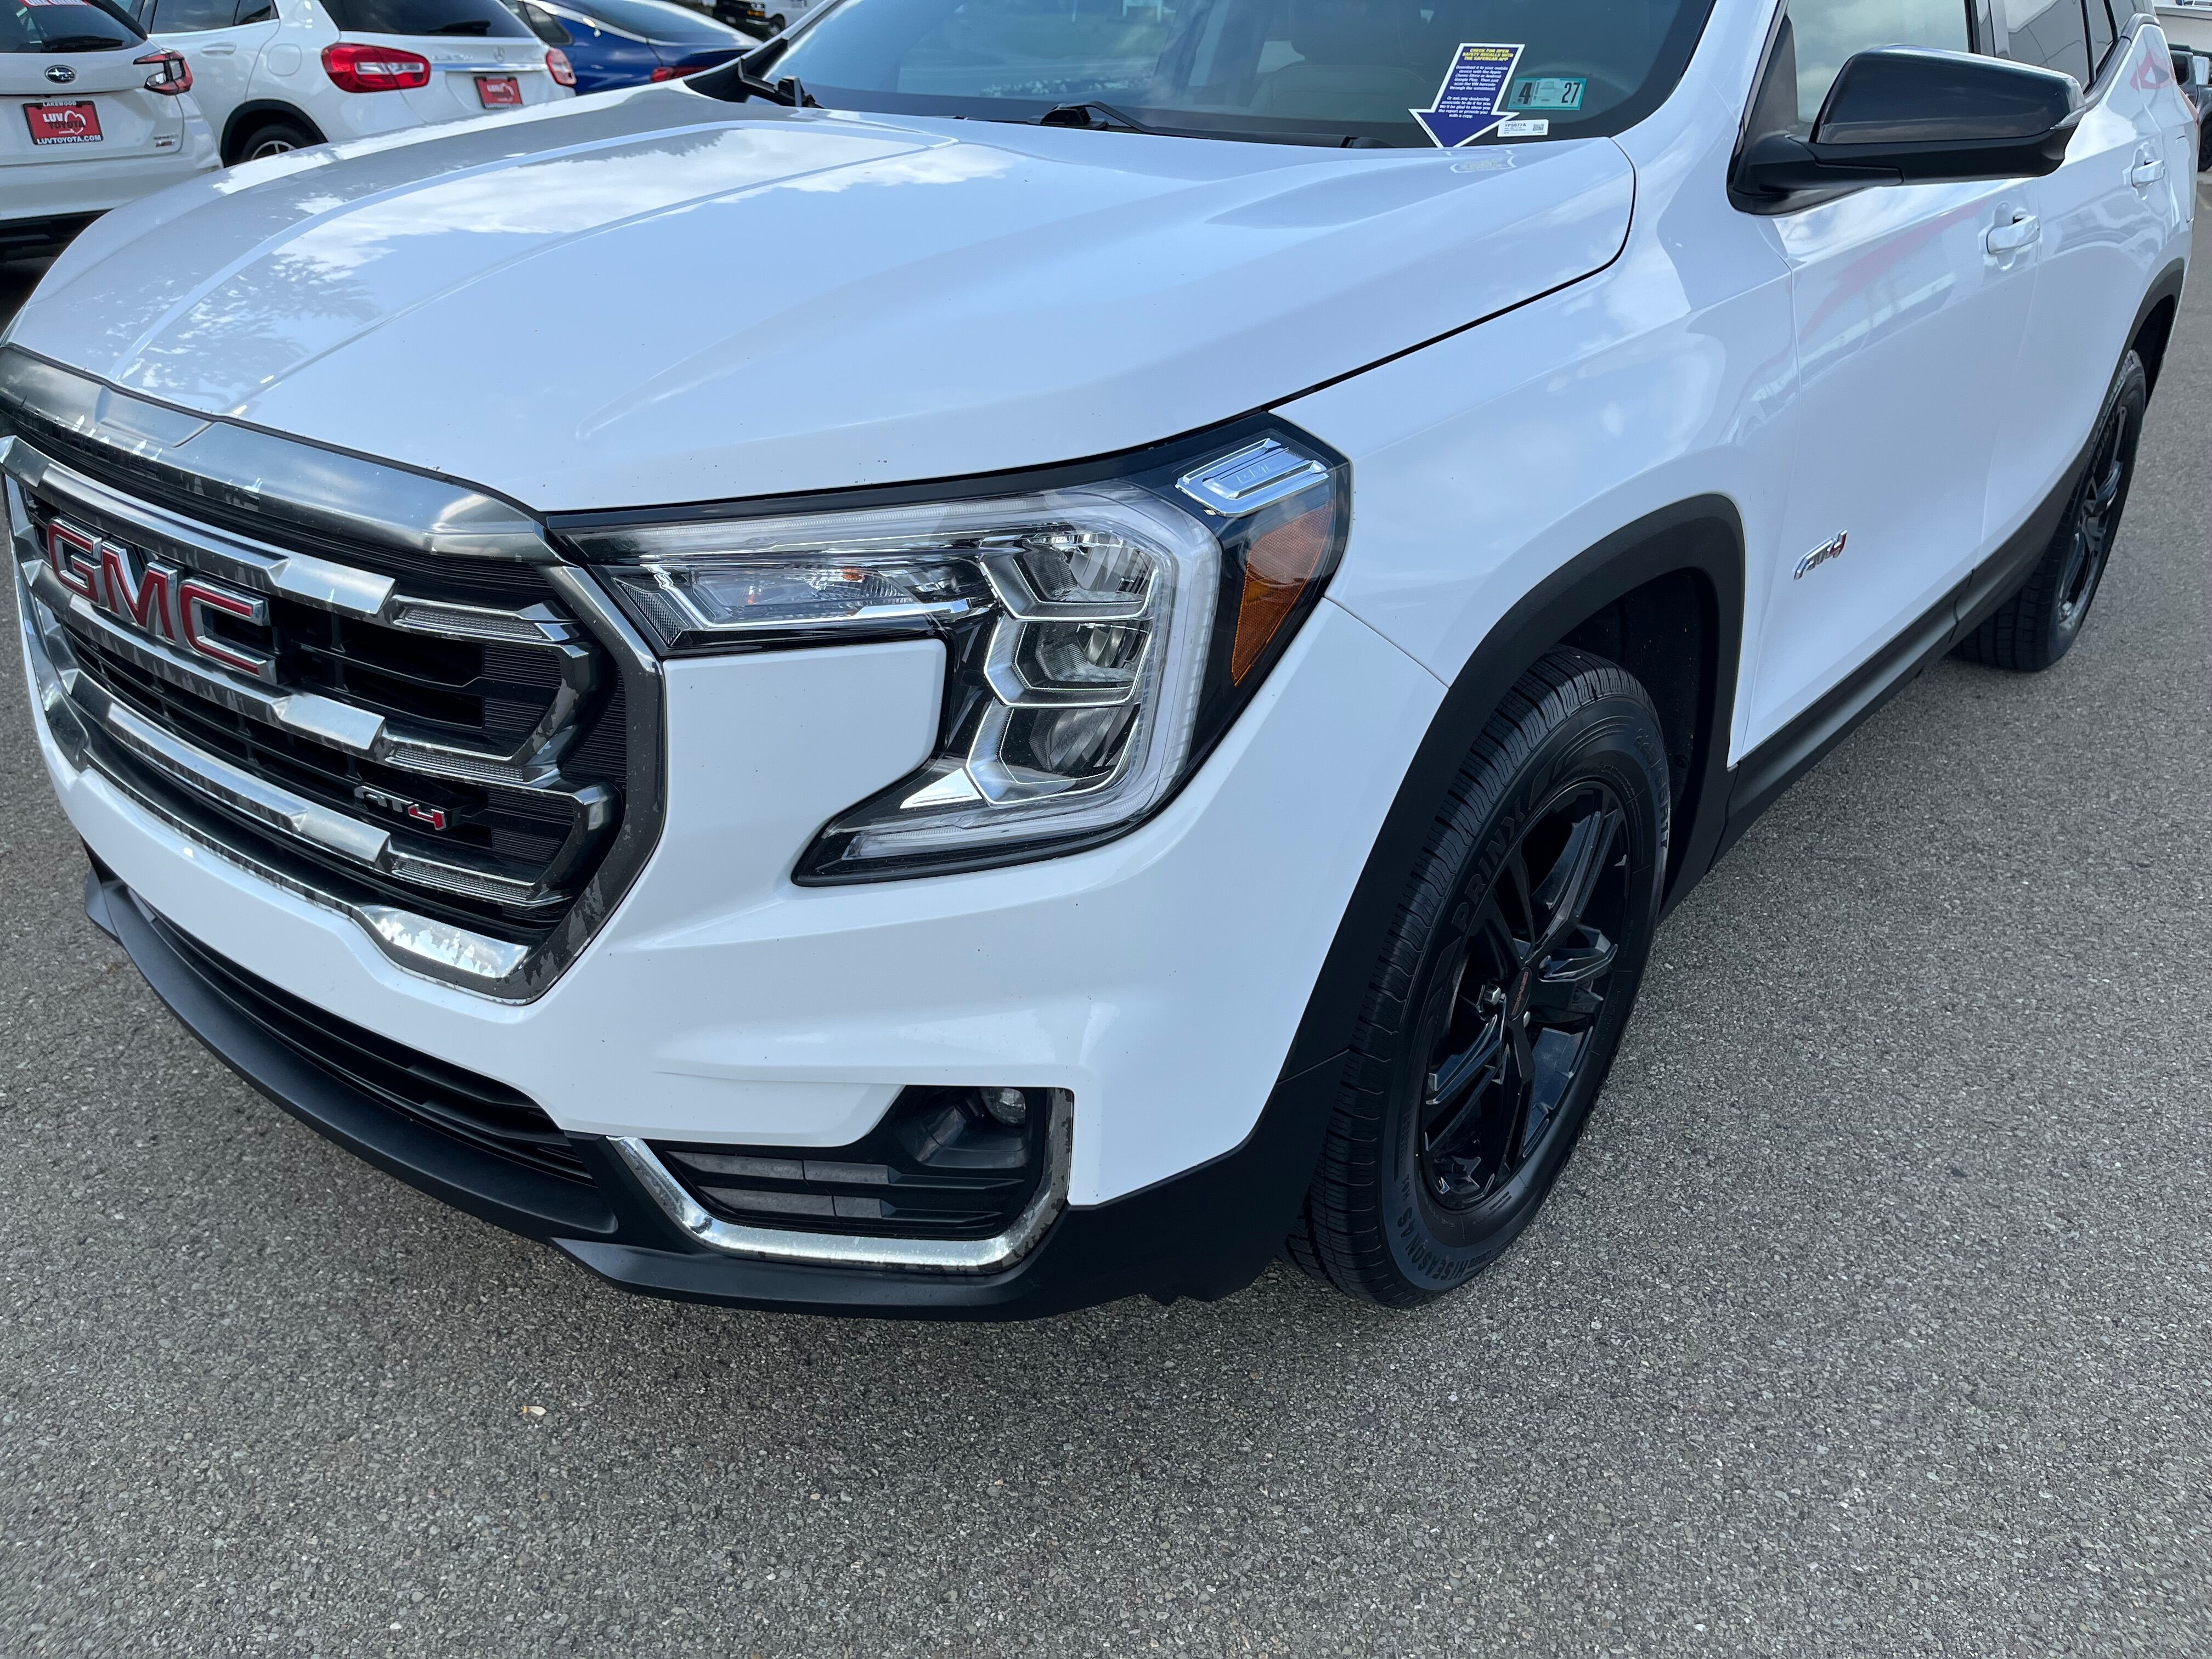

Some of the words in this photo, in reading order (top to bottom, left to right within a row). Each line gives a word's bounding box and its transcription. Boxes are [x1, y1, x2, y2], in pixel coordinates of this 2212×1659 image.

[1519, 82, 1533, 104] 4
[1561, 82, 1581, 103] 27
[42, 113, 63, 122] LUV
[49, 120, 85, 129] TOYOTA
[37, 134, 101, 145] LUVTOYOTA.COM
[47, 516, 278, 685] GMC
[1451, 795, 1526, 932] PRINX
[1510, 970, 1530, 1015] GMC
